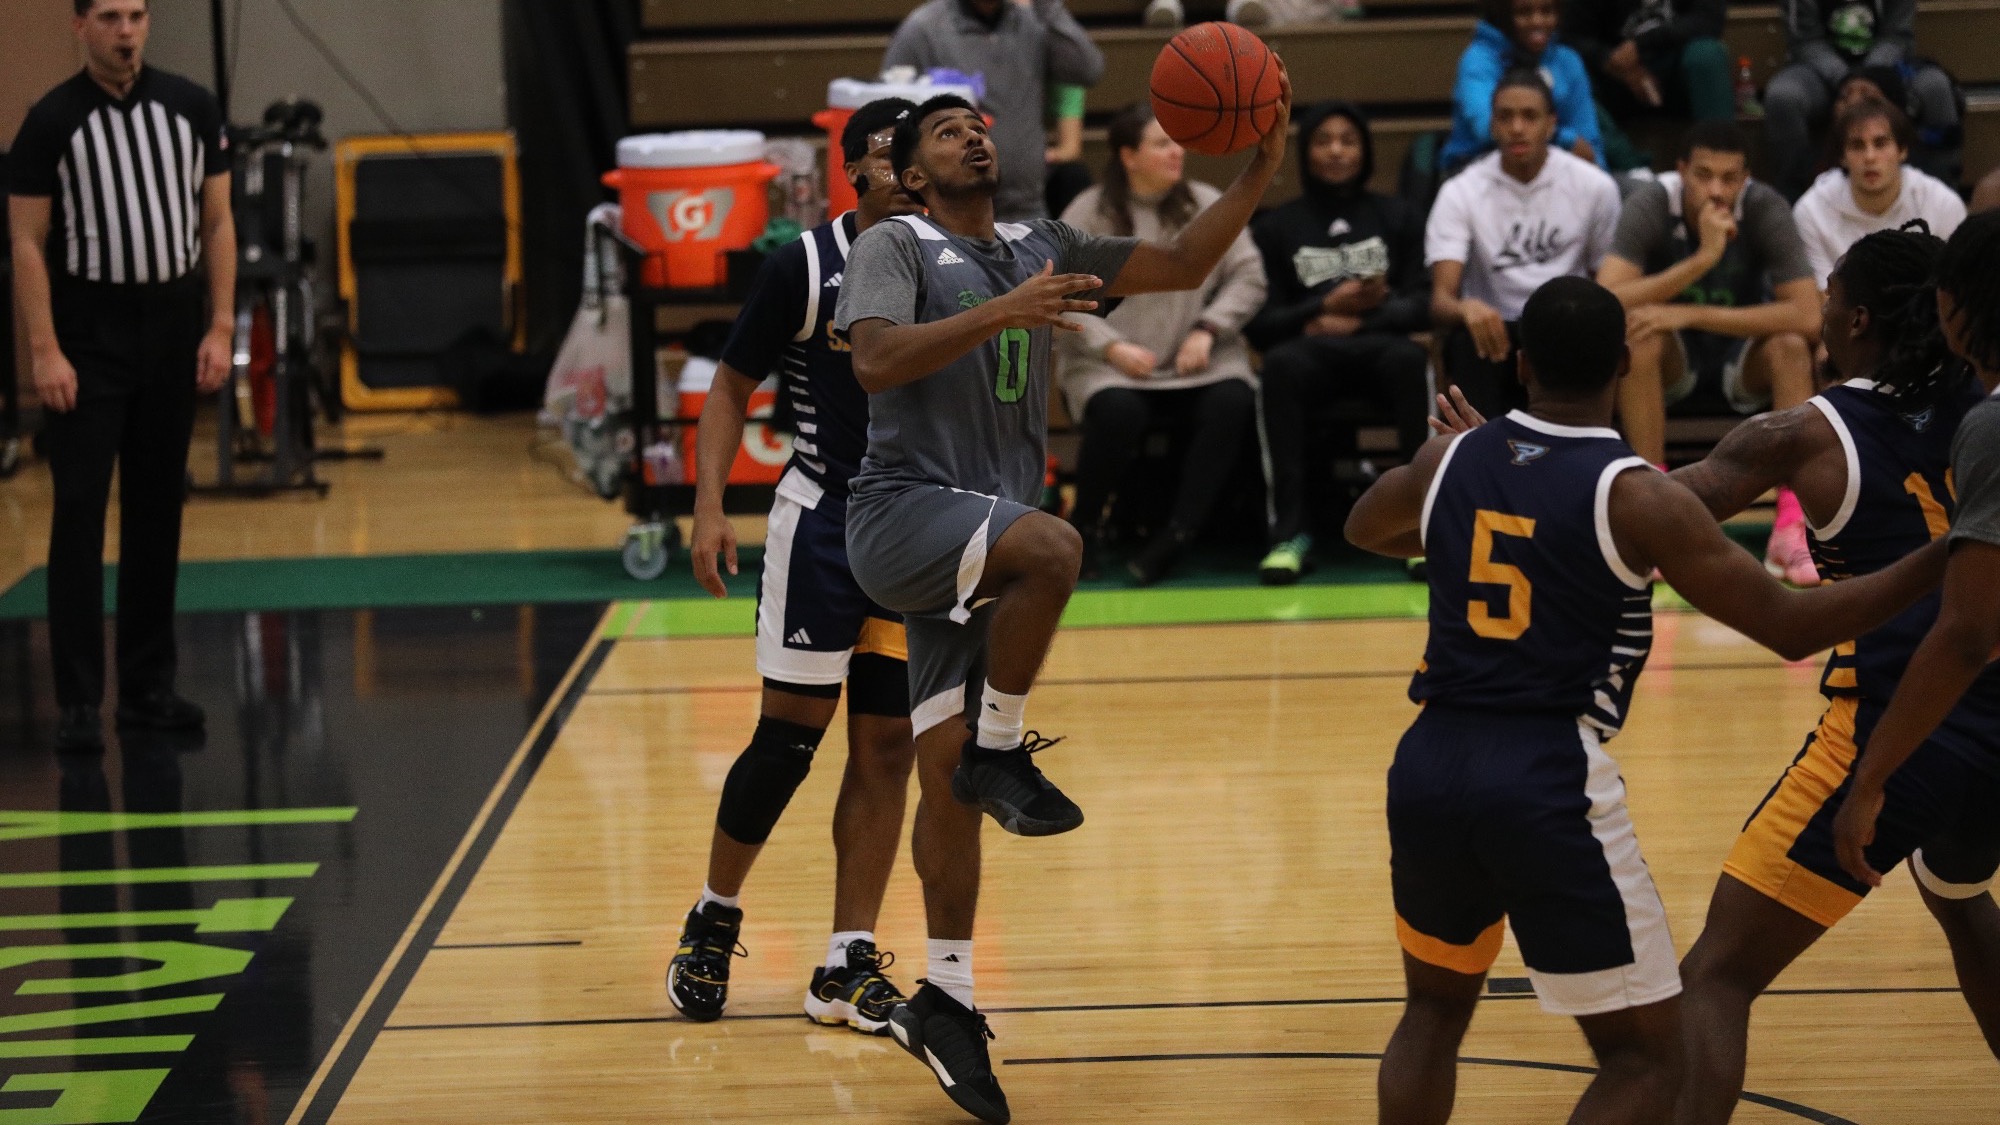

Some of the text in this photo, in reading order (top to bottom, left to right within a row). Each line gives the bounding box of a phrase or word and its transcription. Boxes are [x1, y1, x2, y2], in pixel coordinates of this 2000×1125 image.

[674, 194, 705, 231] G
[937, 257, 964, 266] adidas
[995, 328, 1031, 403] 0
[1467, 509, 1537, 640] 5
